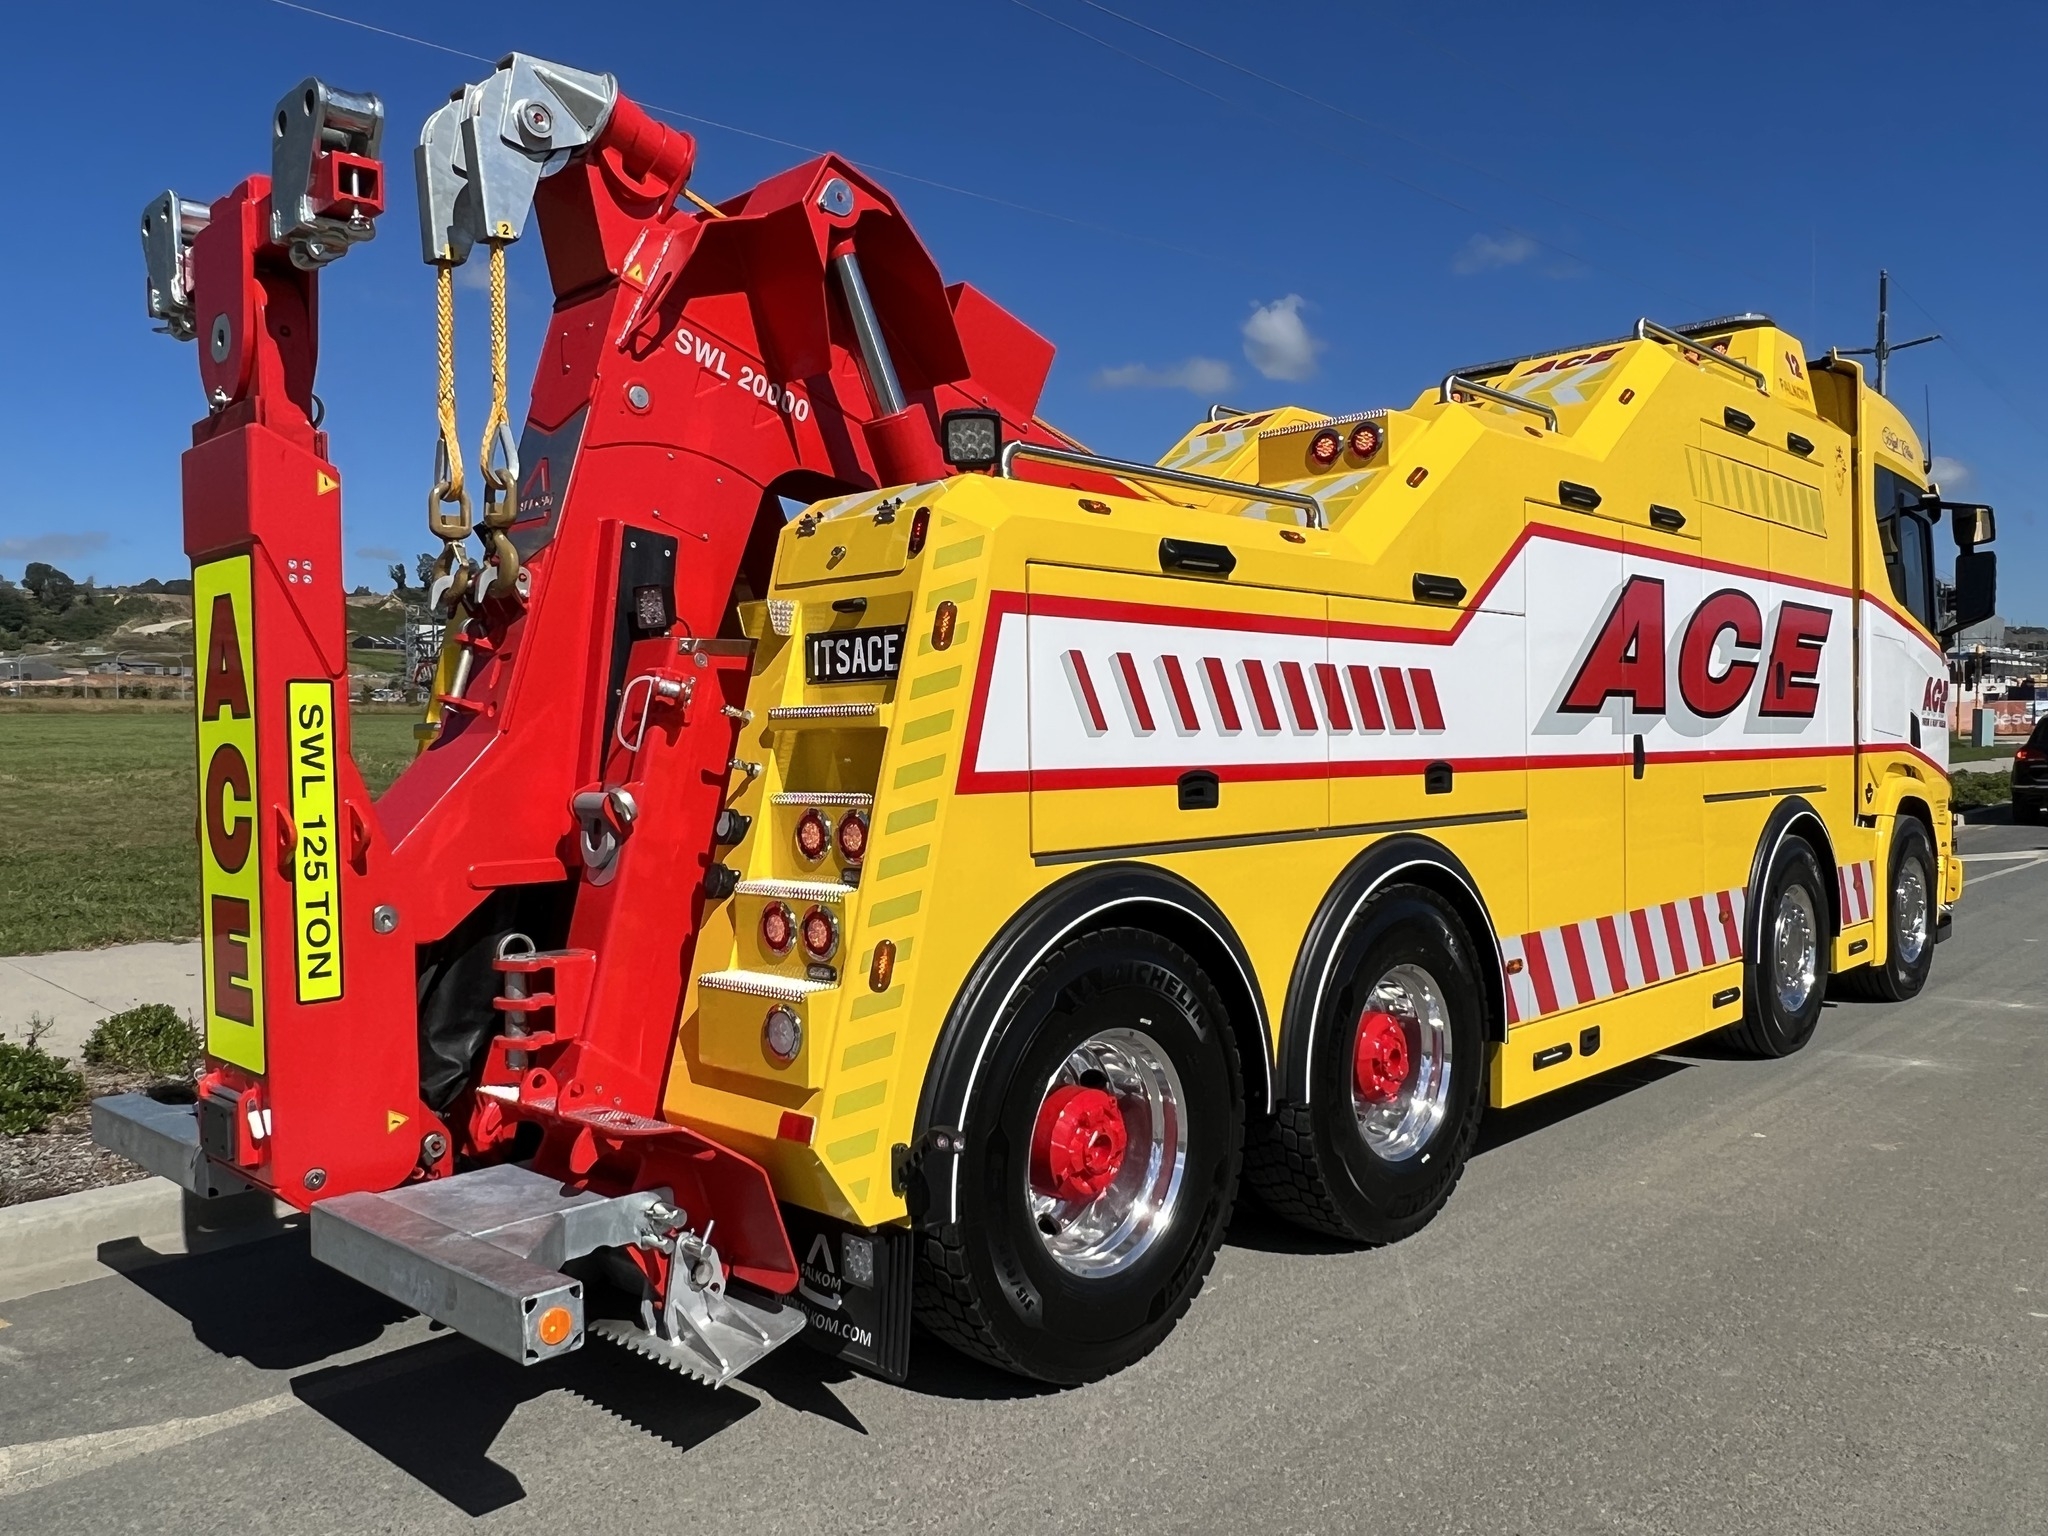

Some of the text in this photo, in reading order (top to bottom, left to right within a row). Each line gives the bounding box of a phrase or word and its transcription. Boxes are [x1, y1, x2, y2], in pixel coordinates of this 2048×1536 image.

[501, 223, 510, 235] 2
[674, 328, 809, 422] SWL 20000
[813, 633, 899, 676] ITSACE
[1555, 573, 1833, 719] ACE
[202, 592, 254, 1027] ACE
[298, 704, 333, 980] SWL 125 TON
[800, 1262, 842, 1291] FALKOM
